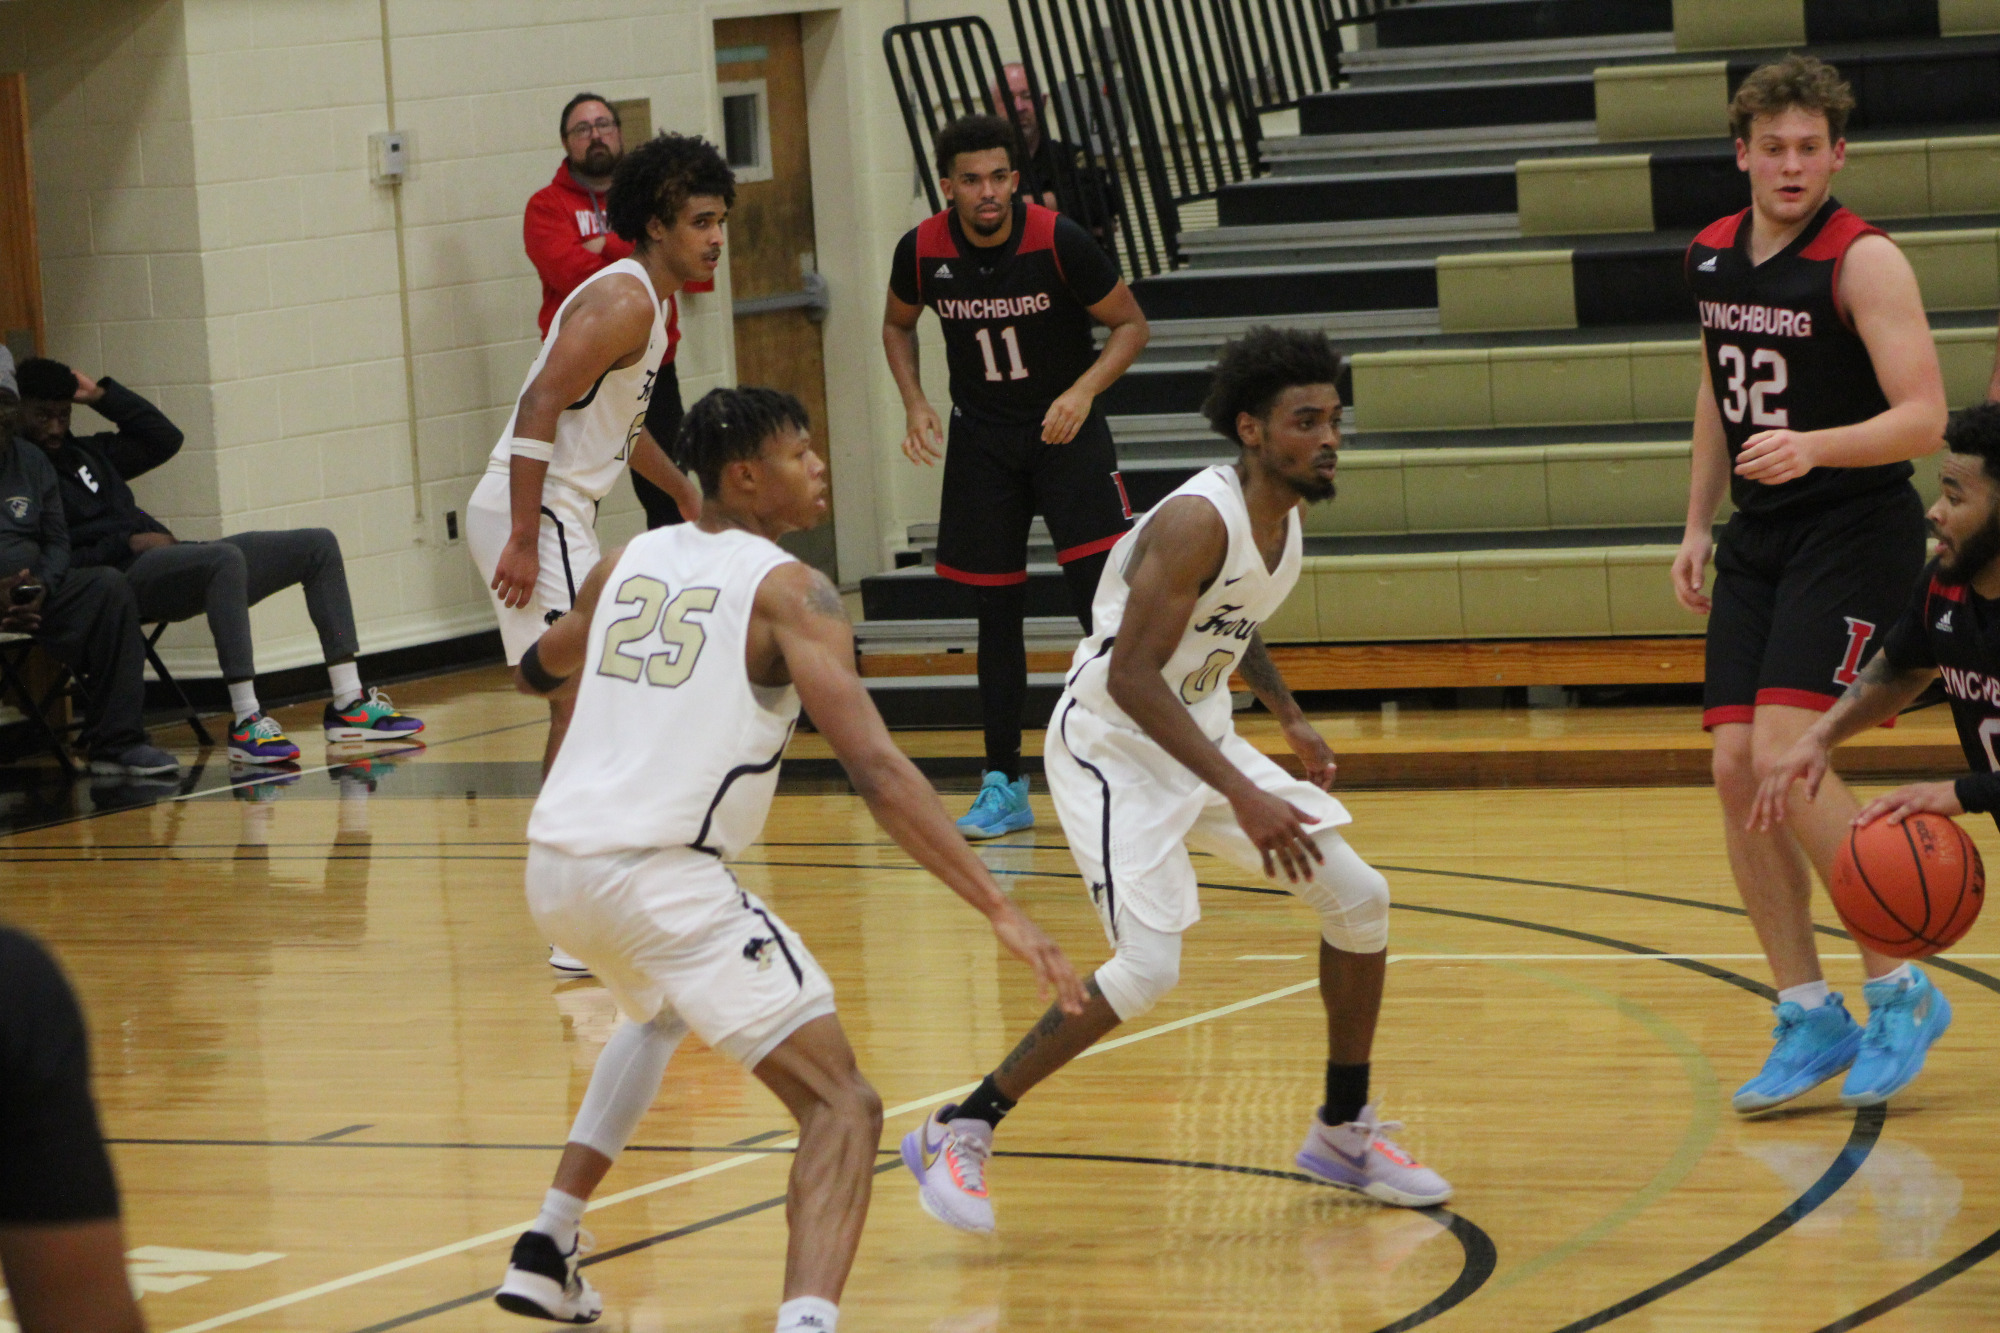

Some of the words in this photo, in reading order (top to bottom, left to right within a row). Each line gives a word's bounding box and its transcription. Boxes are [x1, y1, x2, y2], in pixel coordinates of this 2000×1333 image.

[936, 293, 1050, 319] LYNCHBURG
[1699, 300, 1812, 338] LYNCHBURG
[975, 326, 1029, 381] 11
[1718, 344, 1788, 428] 32
[596, 574, 721, 689] 25
